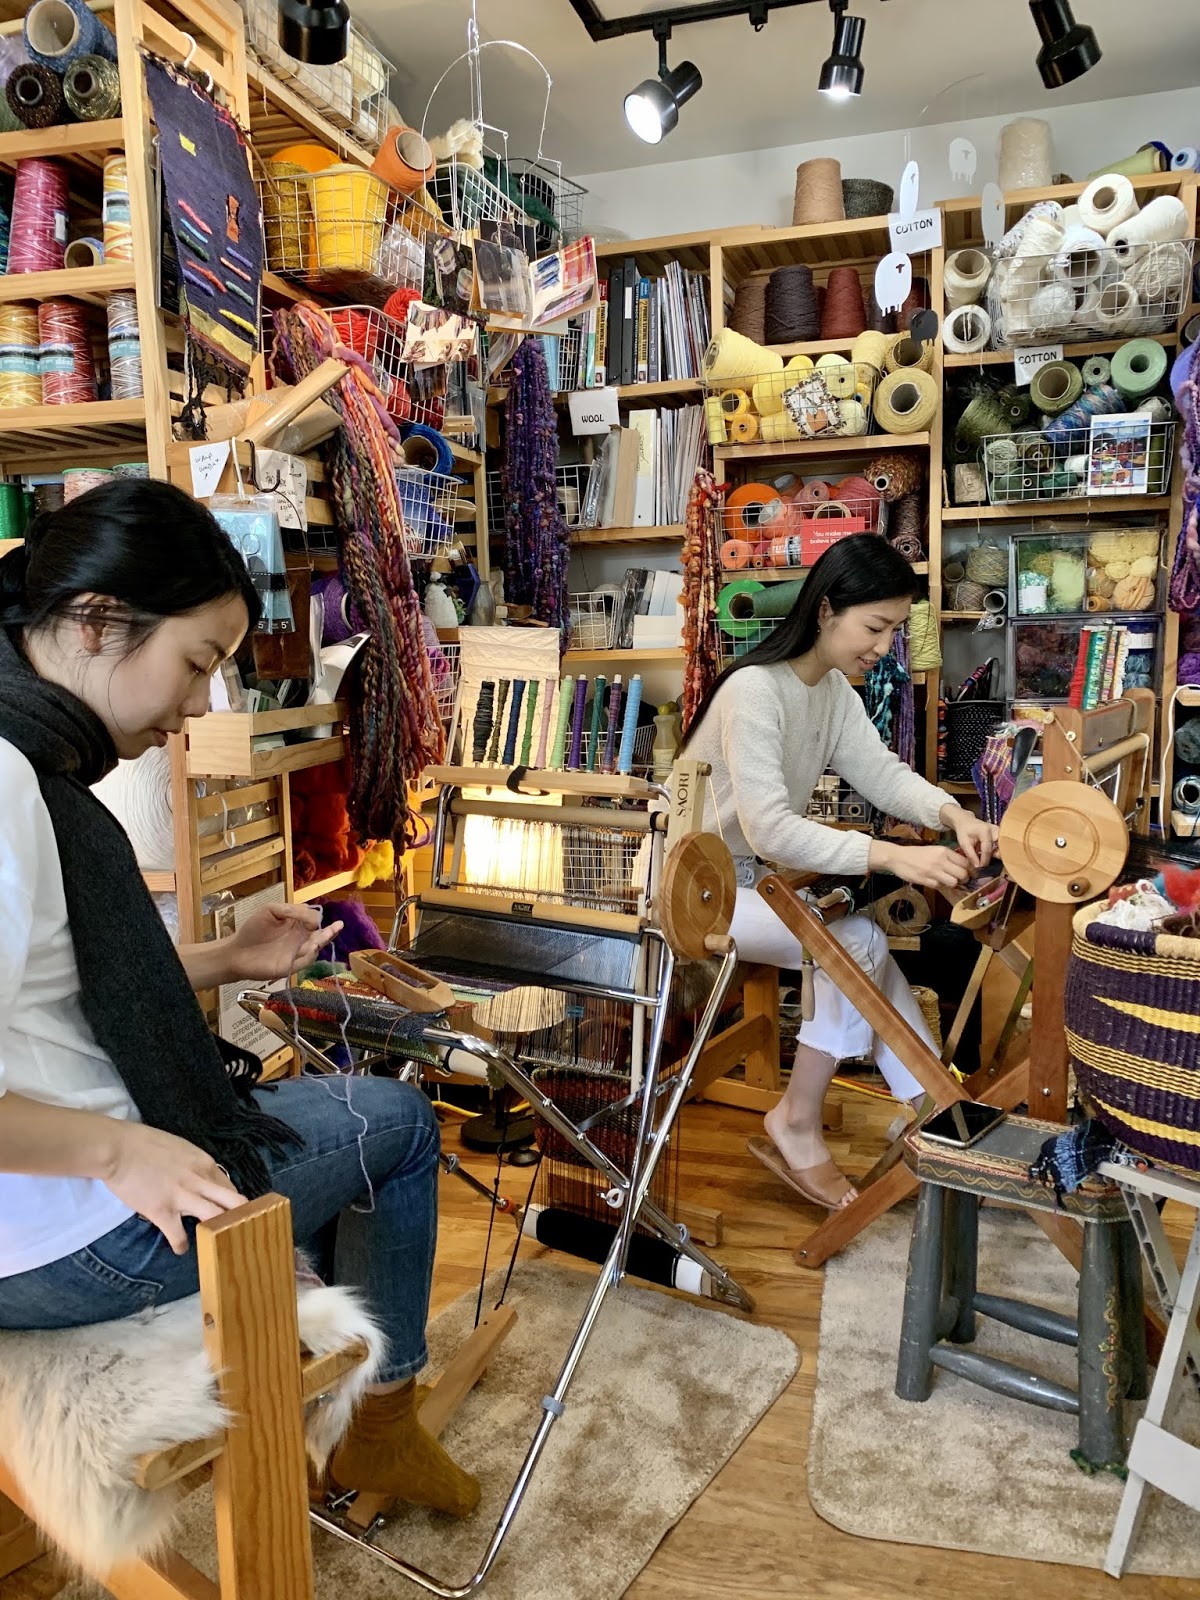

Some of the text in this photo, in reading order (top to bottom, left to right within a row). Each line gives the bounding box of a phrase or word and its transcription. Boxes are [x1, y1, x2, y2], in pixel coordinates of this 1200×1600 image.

[1018, 351, 1057, 365] COTTON
[581, 414, 605, 423] WOOL
[677, 773, 690, 818] SAORI
